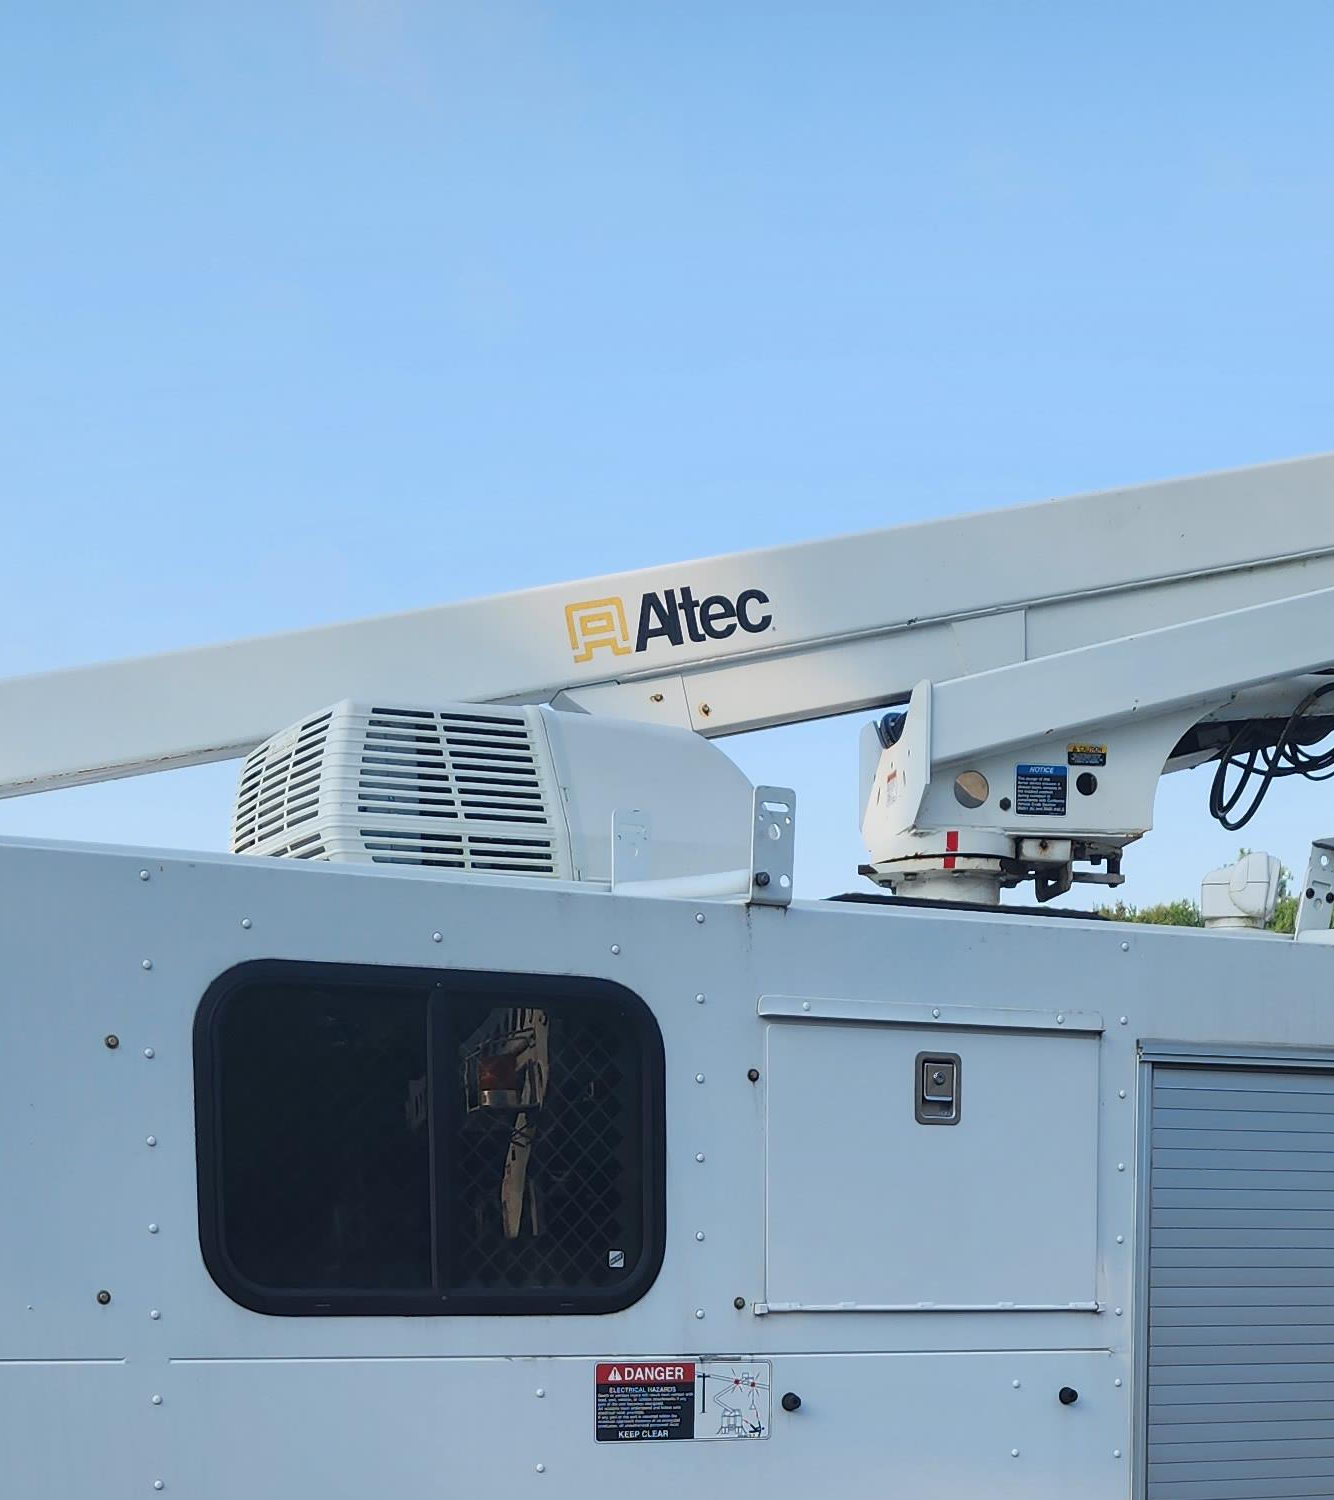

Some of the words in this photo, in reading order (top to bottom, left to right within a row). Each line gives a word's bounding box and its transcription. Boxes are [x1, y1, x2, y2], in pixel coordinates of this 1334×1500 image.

[635, 586, 772, 652] Altec
[1029, 766, 1055, 774] NOTICE
[624, 1366, 684, 1381] DANGER
[609, 1386, 646, 1394] ELECTRICAL
[618, 1430, 640, 1439] KEEP
[641, 1429, 669, 1438] CLEAR
